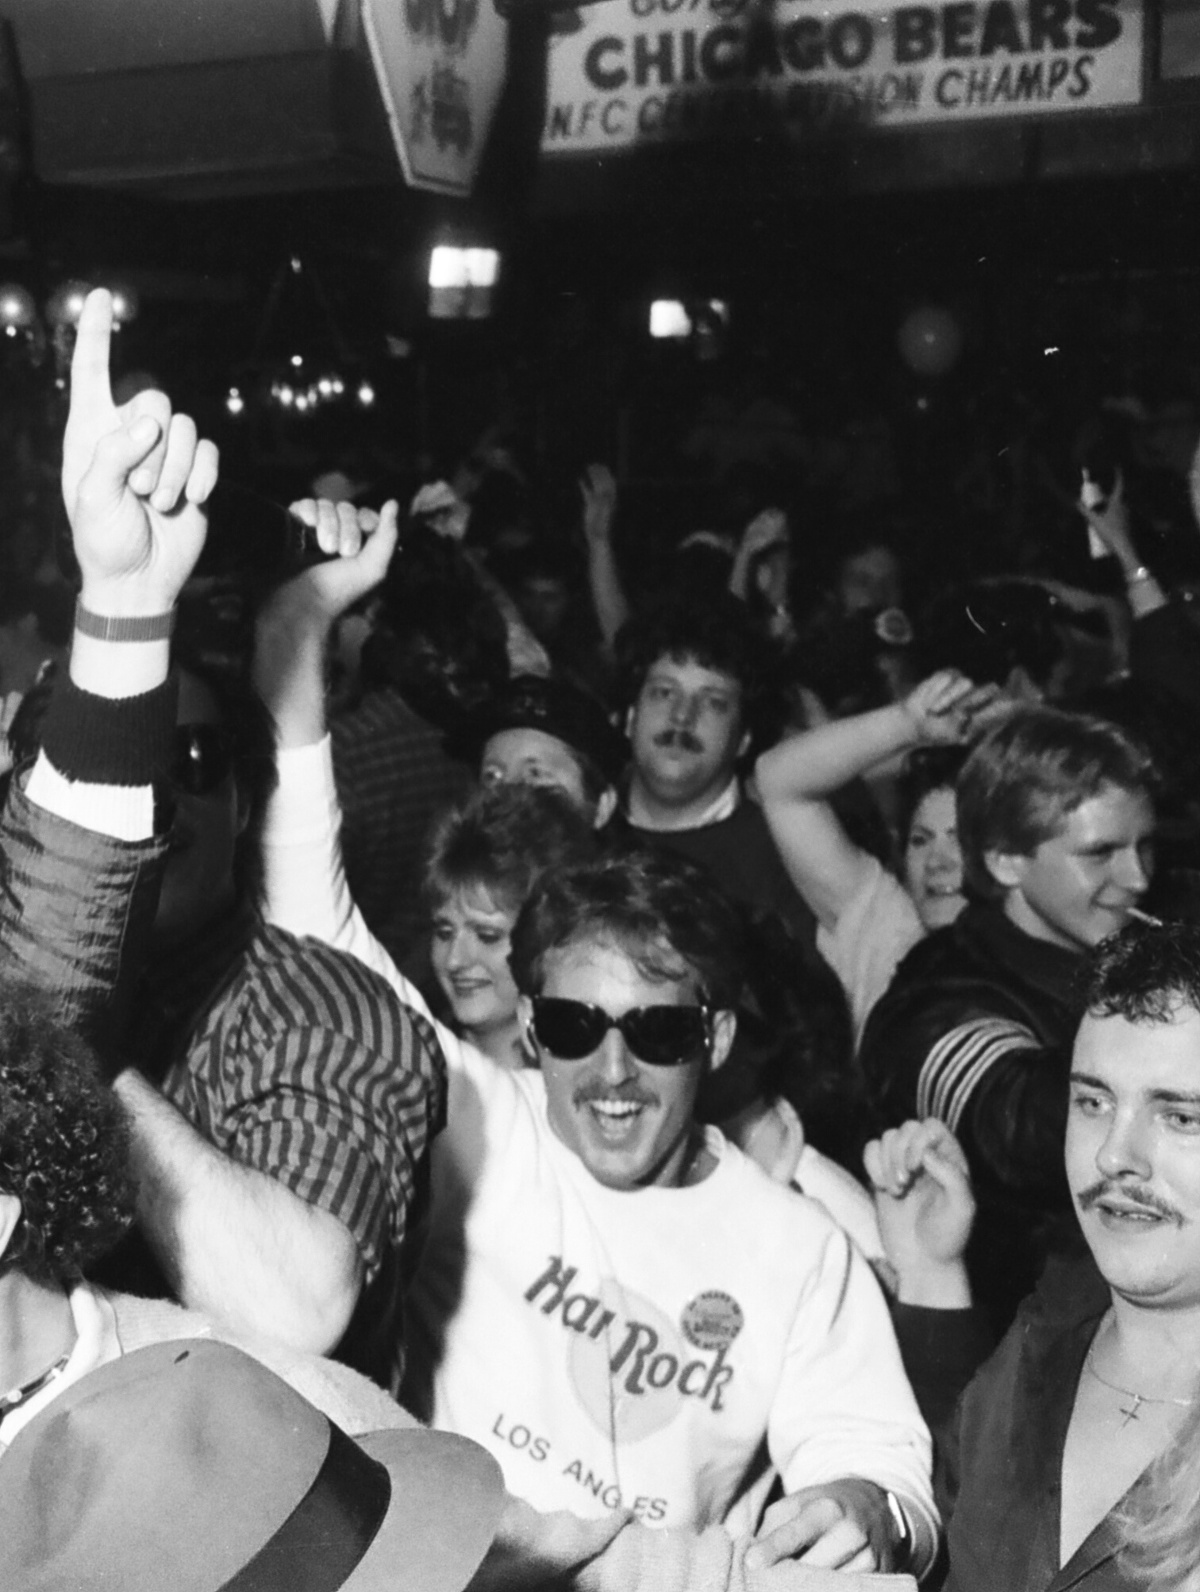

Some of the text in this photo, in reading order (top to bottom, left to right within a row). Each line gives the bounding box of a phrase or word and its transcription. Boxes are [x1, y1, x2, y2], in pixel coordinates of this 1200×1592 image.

[585, 0, 1123, 91] CHICGO BEARS
[934, 54, 1095, 109] CHAMPS
[523, 1255, 617, 1340] Har
[609, 1321, 735, 1413] Rock
[492, 1413, 669, 1521] LOS ANGES
